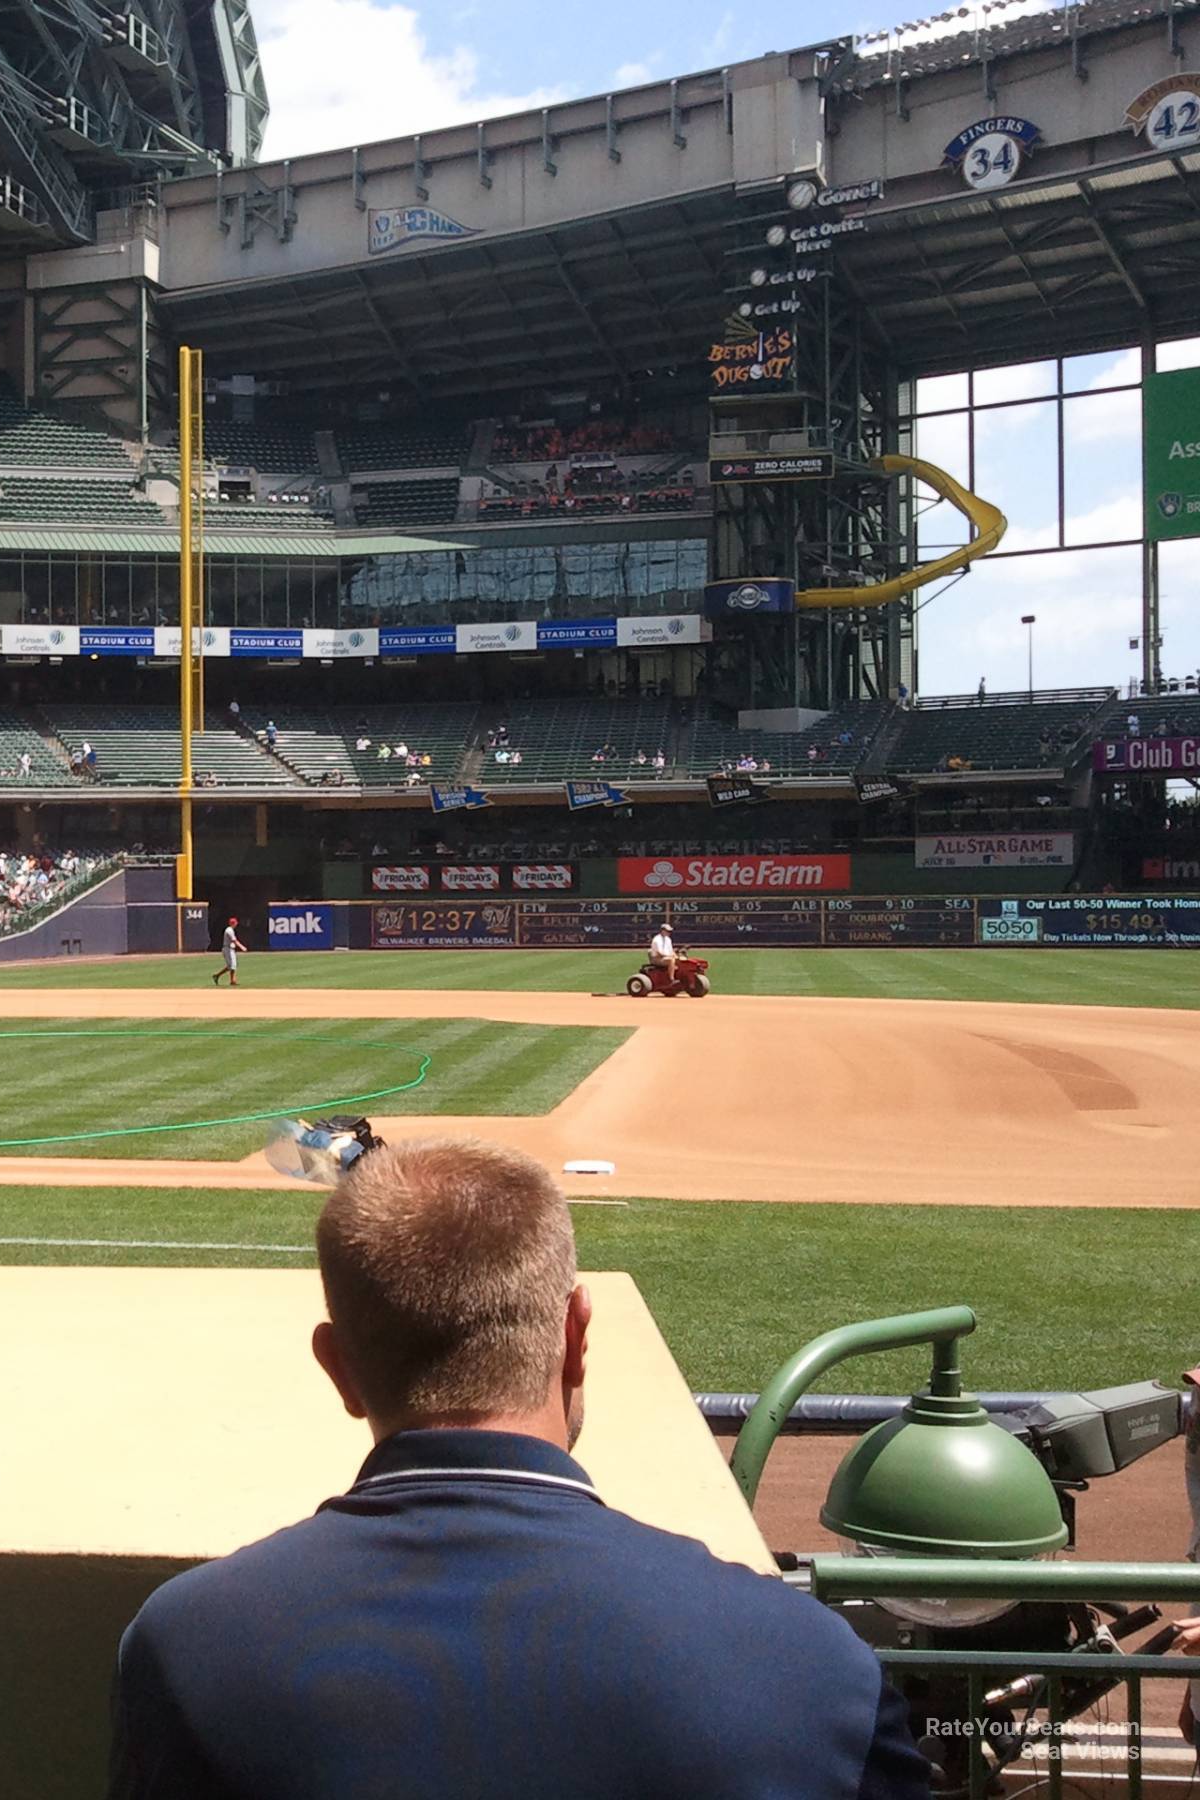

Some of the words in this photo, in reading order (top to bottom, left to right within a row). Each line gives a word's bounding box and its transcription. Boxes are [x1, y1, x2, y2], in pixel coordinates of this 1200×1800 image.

[1153, 101, 1200, 140] 42
[959, 118, 1024, 146] FINGERS
[970, 141, 1015, 181] 34
[818, 181, 878, 206] Gone!
[790, 226, 817, 241] Get
[820, 219, 864, 236] Outta
[796, 239, 832, 254] Here
[770, 271, 794, 284] Get
[797, 268, 816, 282] Up
[755, 303, 778, 316] Get
[781, 300, 800, 314] Up
[707, 327, 792, 362] BERNIE'S
[710, 356, 791, 387] DUGOUT
[755, 461, 778, 470] ZERO
[780, 459, 822, 468] CALORIES
[539, 630, 585, 639] STADIUM
[589, 629, 614, 637] CLUB
[631, 627, 663, 636] Johnson
[16, 636, 44, 645] Johnson
[82, 637, 126, 646] STADIUM
[129, 637, 152, 645] CLUB
[233, 639, 275, 647] STADIUM
[278, 639, 301, 647] CLUB
[381, 637, 425, 645] STADIUM
[429, 635, 454, 643] CLUB
[470, 634, 500, 643] Johnson
[316, 640, 344, 648] Johnson
[1129, 741, 1173, 768] Club
[523, 904, 547, 913] FTW
[580, 903, 608, 912] 7:05
[637, 903, 662, 912] WIS
[674, 902, 698, 911] NAS
[732, 902, 762, 911] 8:05
[792, 901, 816, 910] ALB
[828, 901, 852, 910] BOS
[945, 899, 970, 909] SEA
[1026, 900, 1046, 910] Our
[1049, 900, 1070, 909] Last
[1074, 899, 1103, 909] 50-50
[1106, 899, 1142, 909] Winner
[1145, 899, 1172, 909] Took
[186, 909, 202, 919] 344
[408, 911, 475, 931] 12:37
[584, 925, 604, 933] vs.
[889, 923, 910, 931] vs.
[429, 937, 469, 945] BREWERS
[472, 937, 514, 945] BASEBALL
[850, 932, 893, 941] HARANG
[1043, 934, 1059, 943] Buy
[1062, 933, 1091, 942] Tickets
[1093, 934, 1111, 942] Now
[1114, 934, 1148, 943] Through
